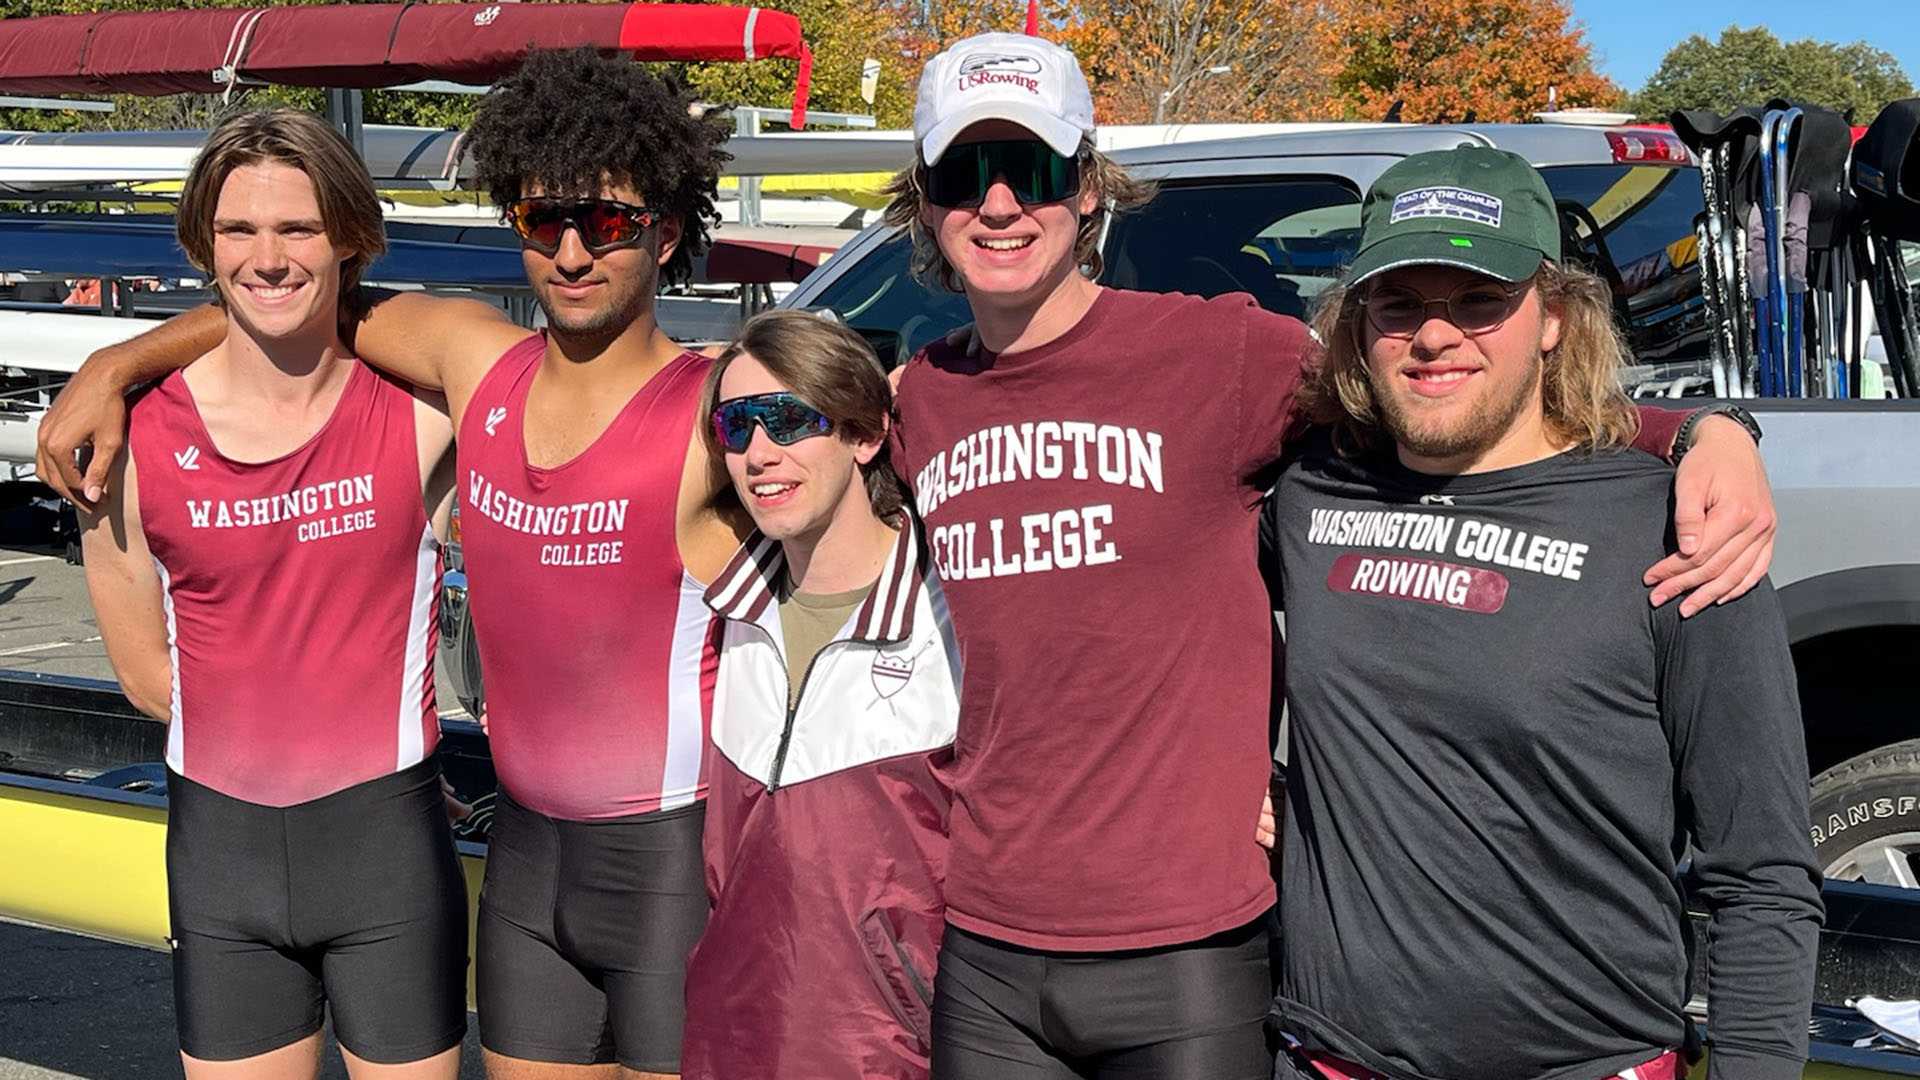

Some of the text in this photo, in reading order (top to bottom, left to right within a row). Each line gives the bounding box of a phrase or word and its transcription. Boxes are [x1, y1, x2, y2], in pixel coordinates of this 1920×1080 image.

[958, 70, 1039, 95] USRowing
[1436, 190, 1457, 200] THE
[911, 421, 1164, 519] WASHINGTON
[186, 474, 374, 528] WASHINGTON
[297, 509, 377, 543] COLLEGE
[469, 469, 629, 536] WASHINGTON
[540, 541, 624, 566] COLLEGE
[933, 504, 1117, 581] COLLEGE
[1307, 508, 1589, 581] WASHINGTON COLLEGE
[1350, 558, 1472, 606] ROWING
[1810, 796, 1920, 848] RANSF
